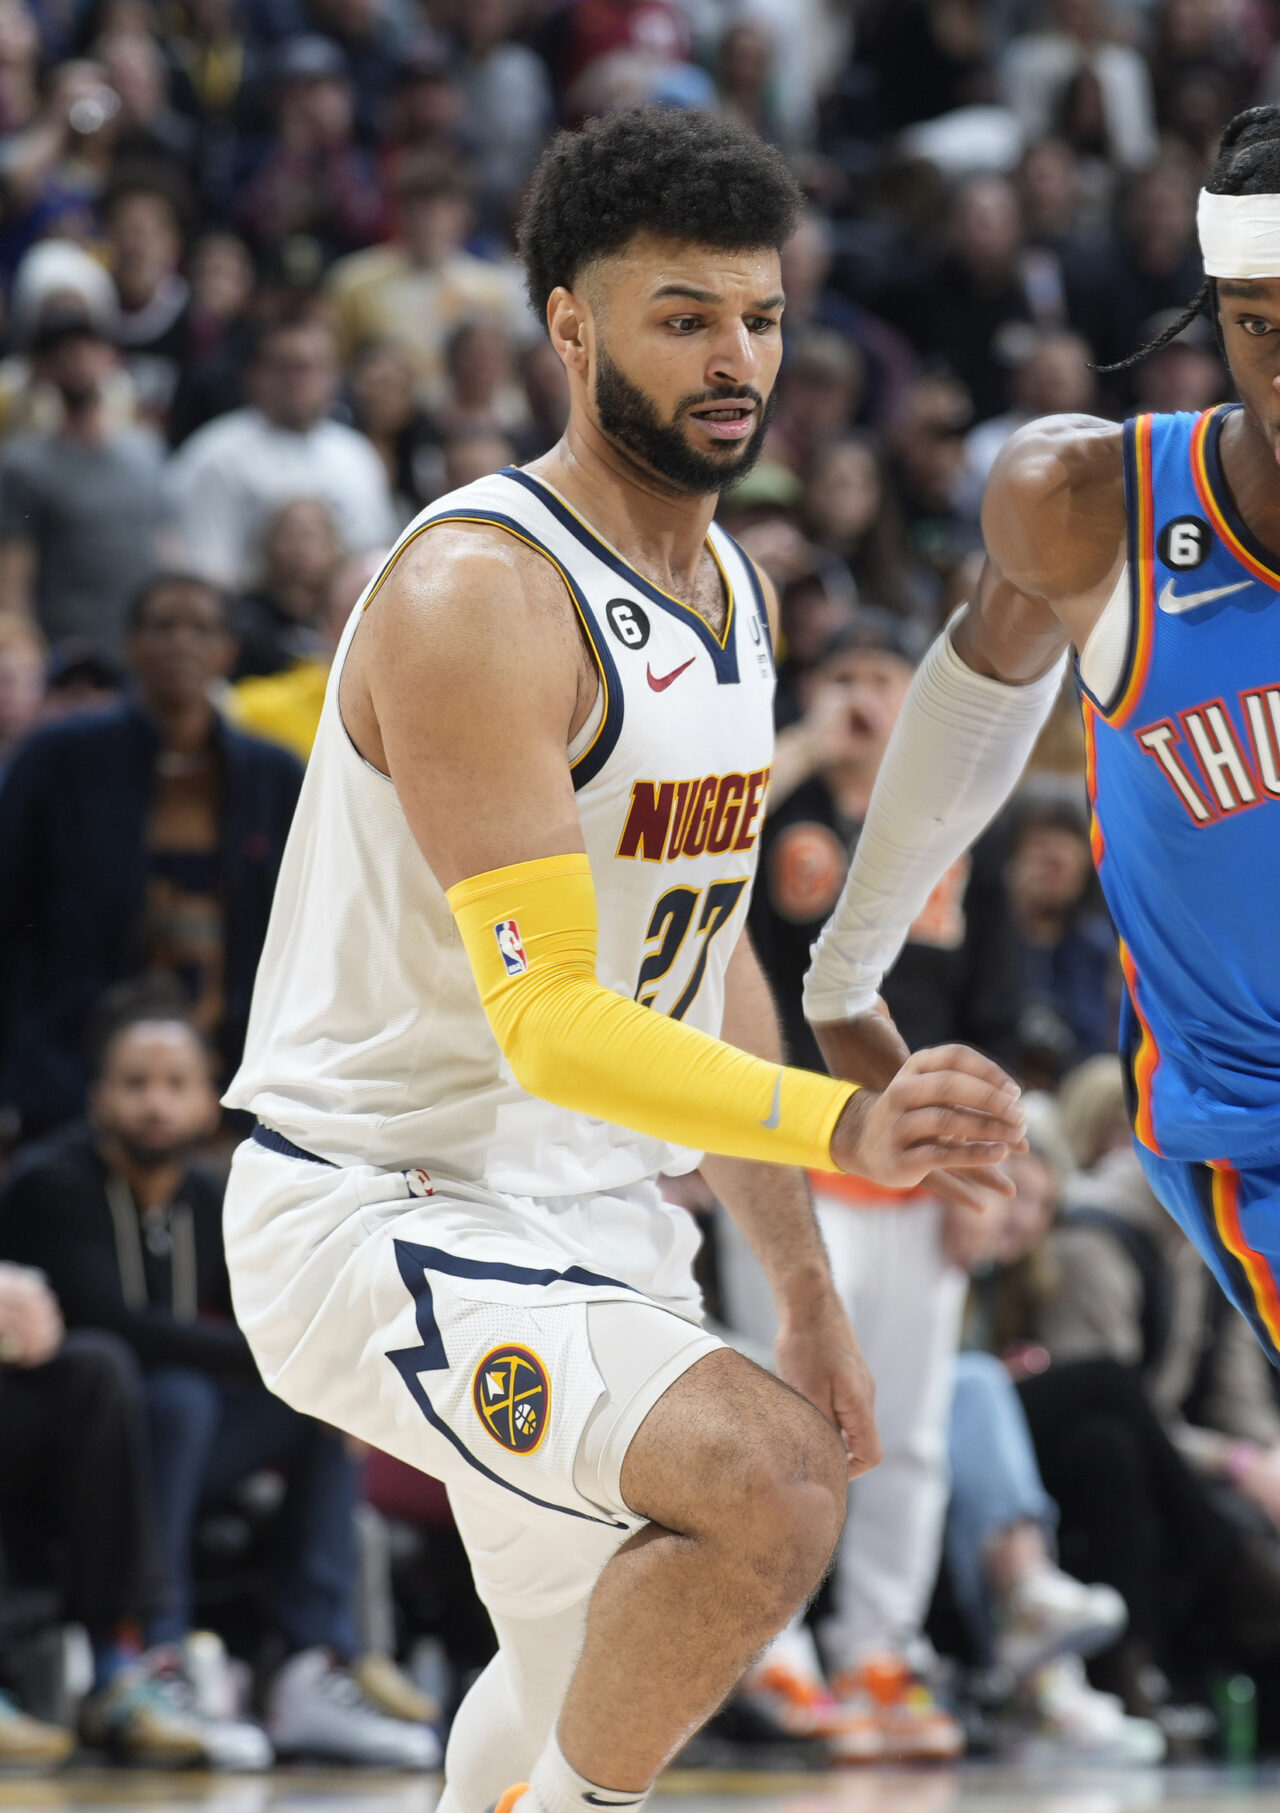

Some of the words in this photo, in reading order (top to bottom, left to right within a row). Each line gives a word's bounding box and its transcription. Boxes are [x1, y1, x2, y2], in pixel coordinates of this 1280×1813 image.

[1168, 522, 1201, 567] 6
[610, 604, 643, 645] 6
[634, 876, 752, 1023] 27
